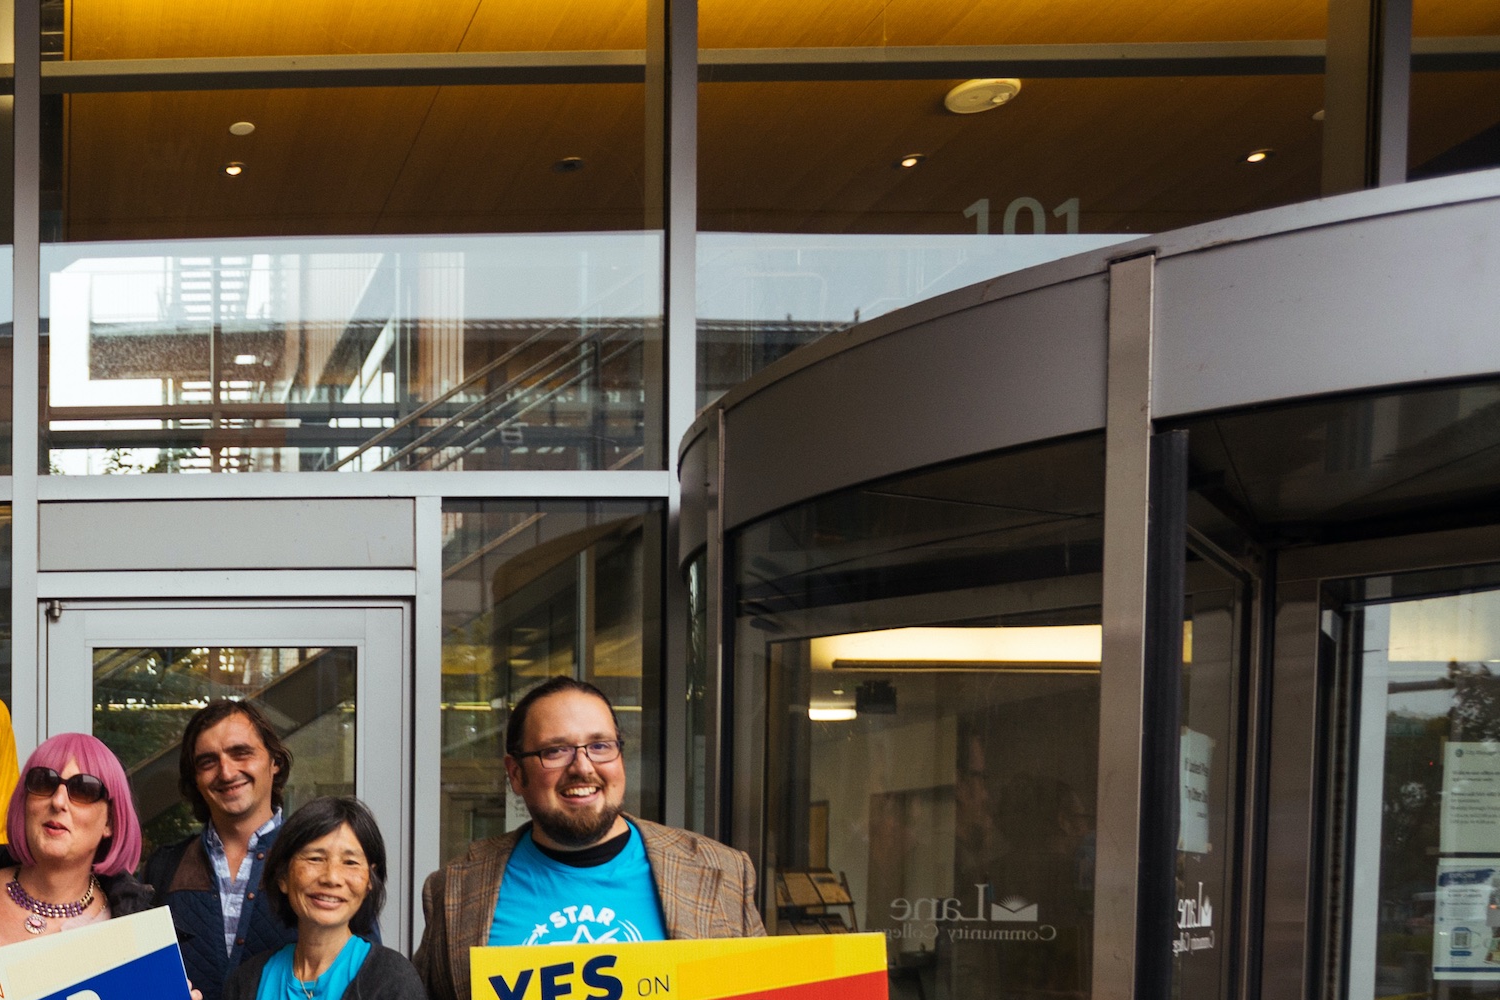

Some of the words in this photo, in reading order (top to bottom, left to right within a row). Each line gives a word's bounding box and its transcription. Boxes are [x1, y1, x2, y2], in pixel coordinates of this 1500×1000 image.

[963, 197, 1079, 234] 101
[550, 905, 615, 928] STAR
[638, 975, 670, 996] ON
